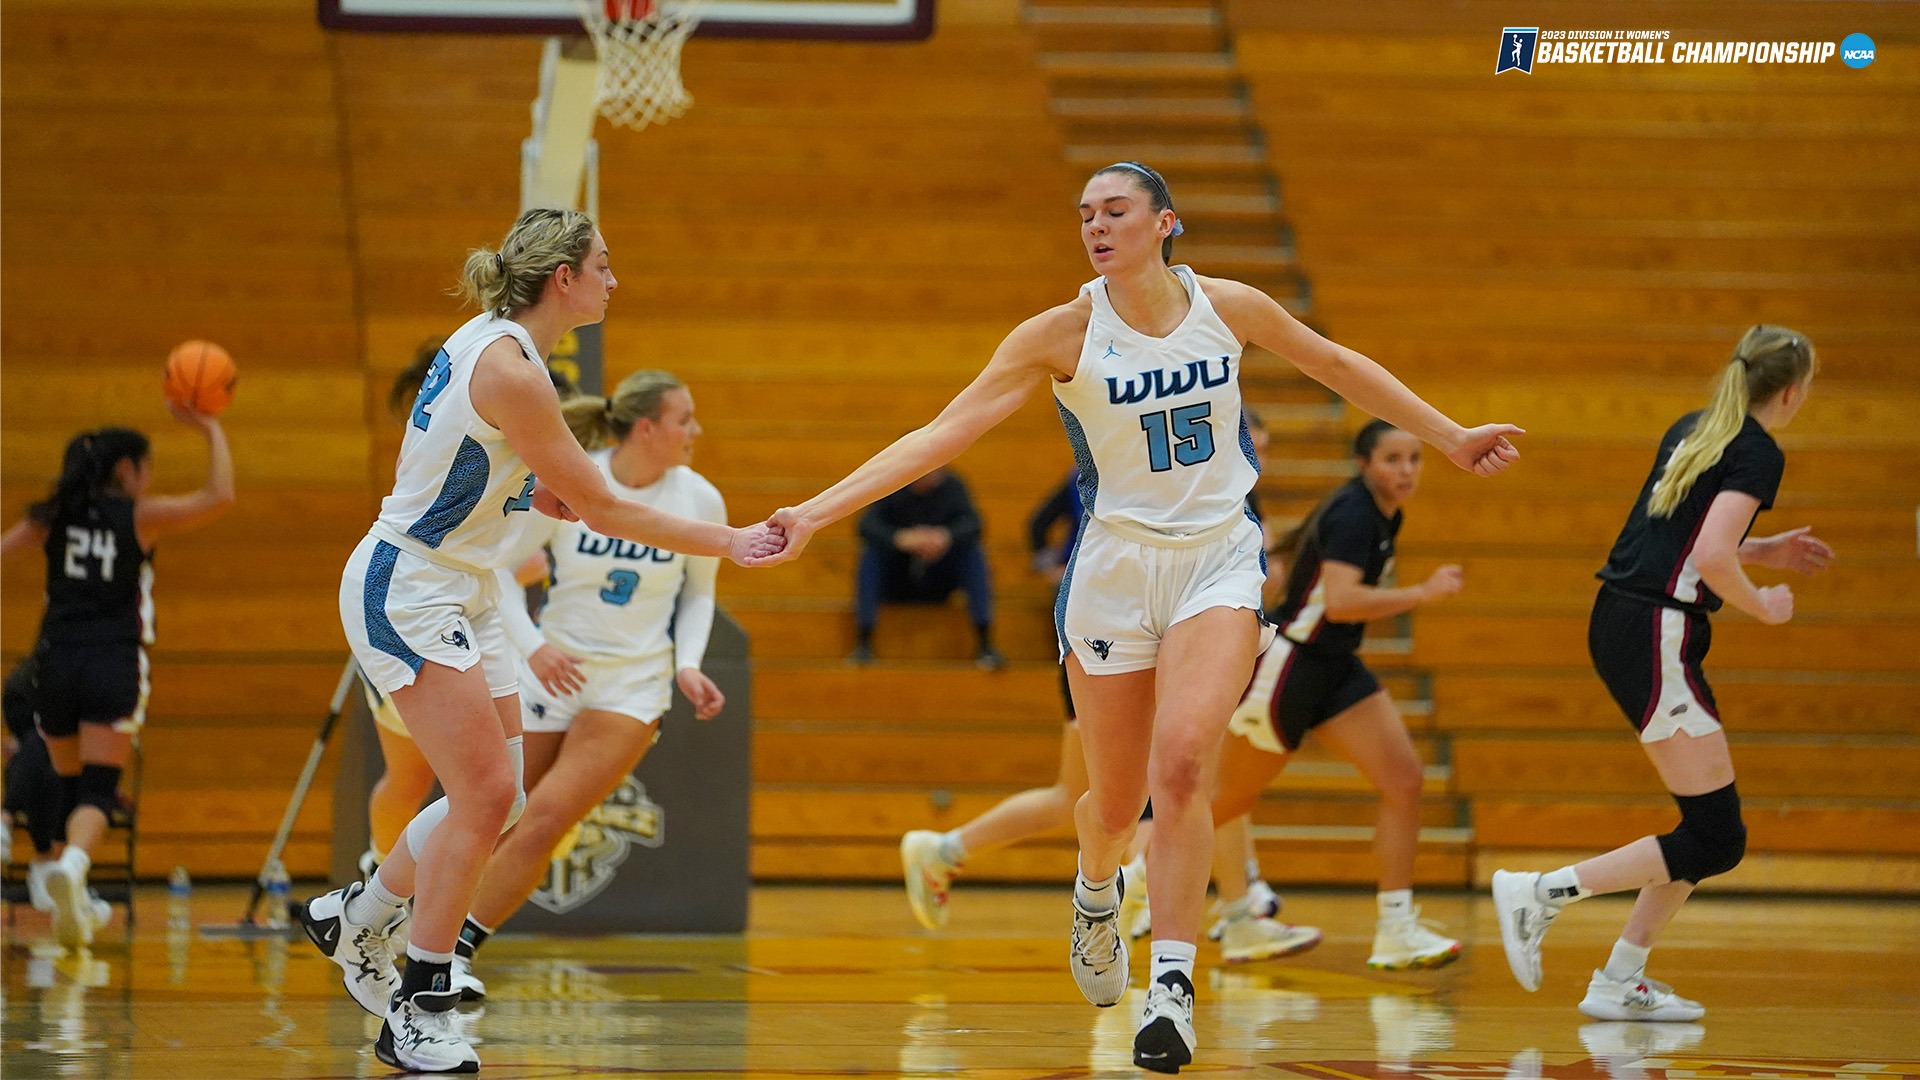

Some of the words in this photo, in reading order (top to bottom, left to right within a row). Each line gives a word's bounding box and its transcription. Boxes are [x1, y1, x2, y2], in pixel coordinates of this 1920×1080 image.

[1104, 356, 1230, 404] WWU
[1139, 401, 1216, 472] 15
[64, 525, 117, 582] 24
[600, 569, 640, 606] 3
